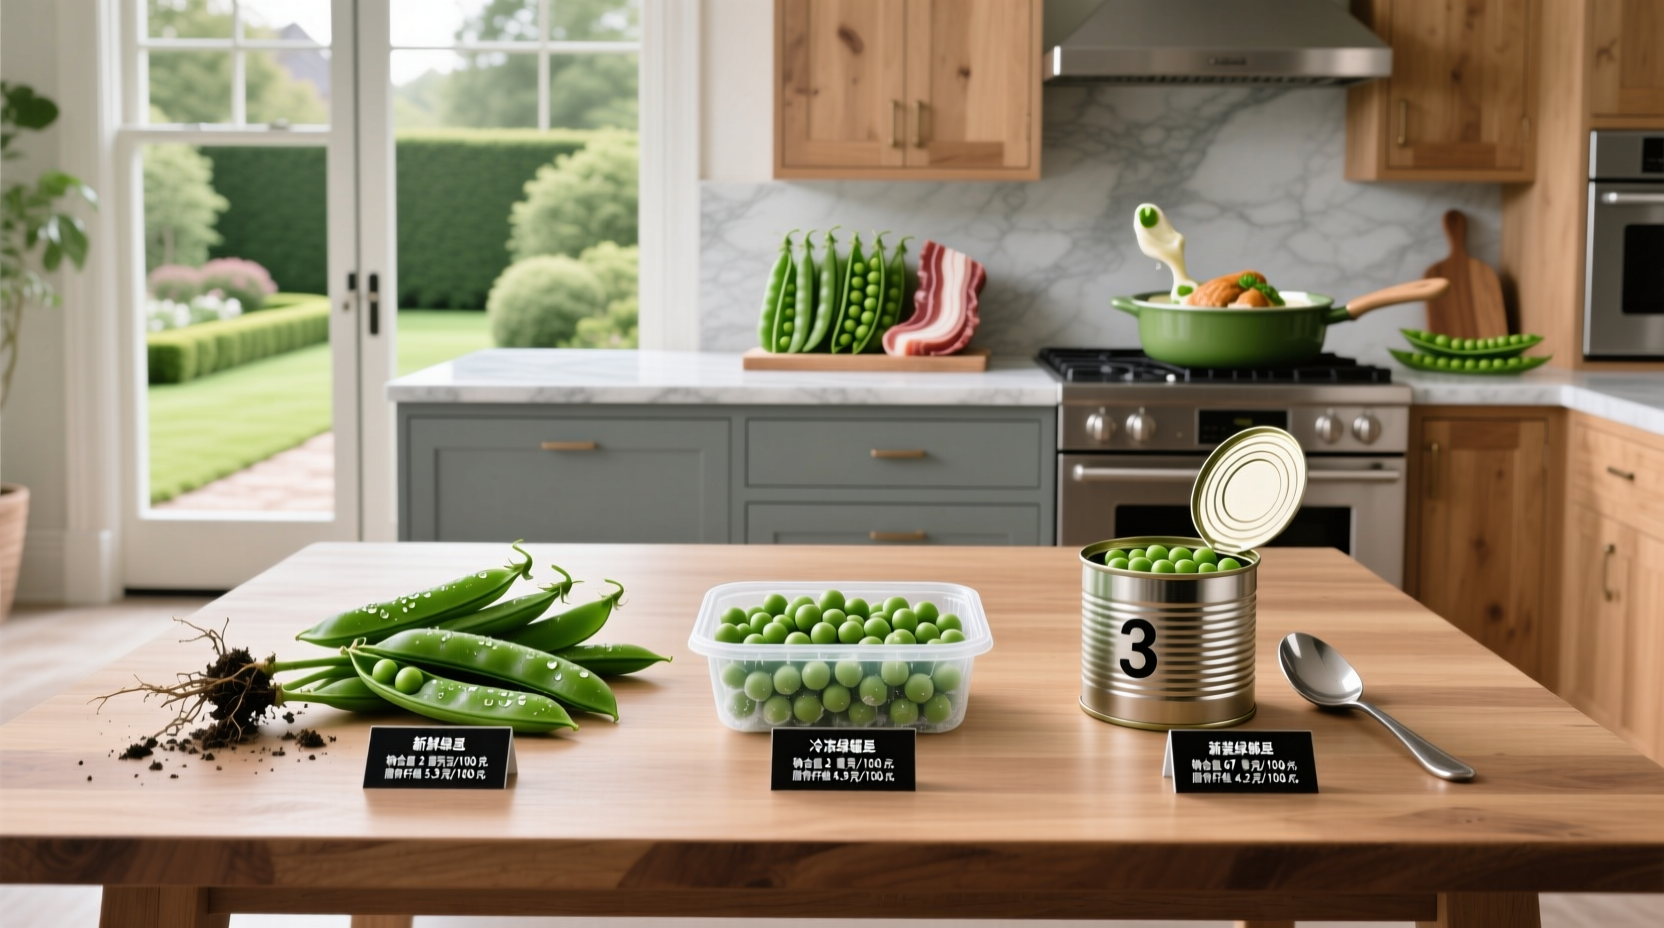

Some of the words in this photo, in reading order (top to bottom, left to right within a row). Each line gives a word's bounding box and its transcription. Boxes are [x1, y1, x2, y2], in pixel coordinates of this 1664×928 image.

[1120, 618, 1158, 679] 3
[418, 756, 425, 767] 2
[824, 758, 832, 769] 2
